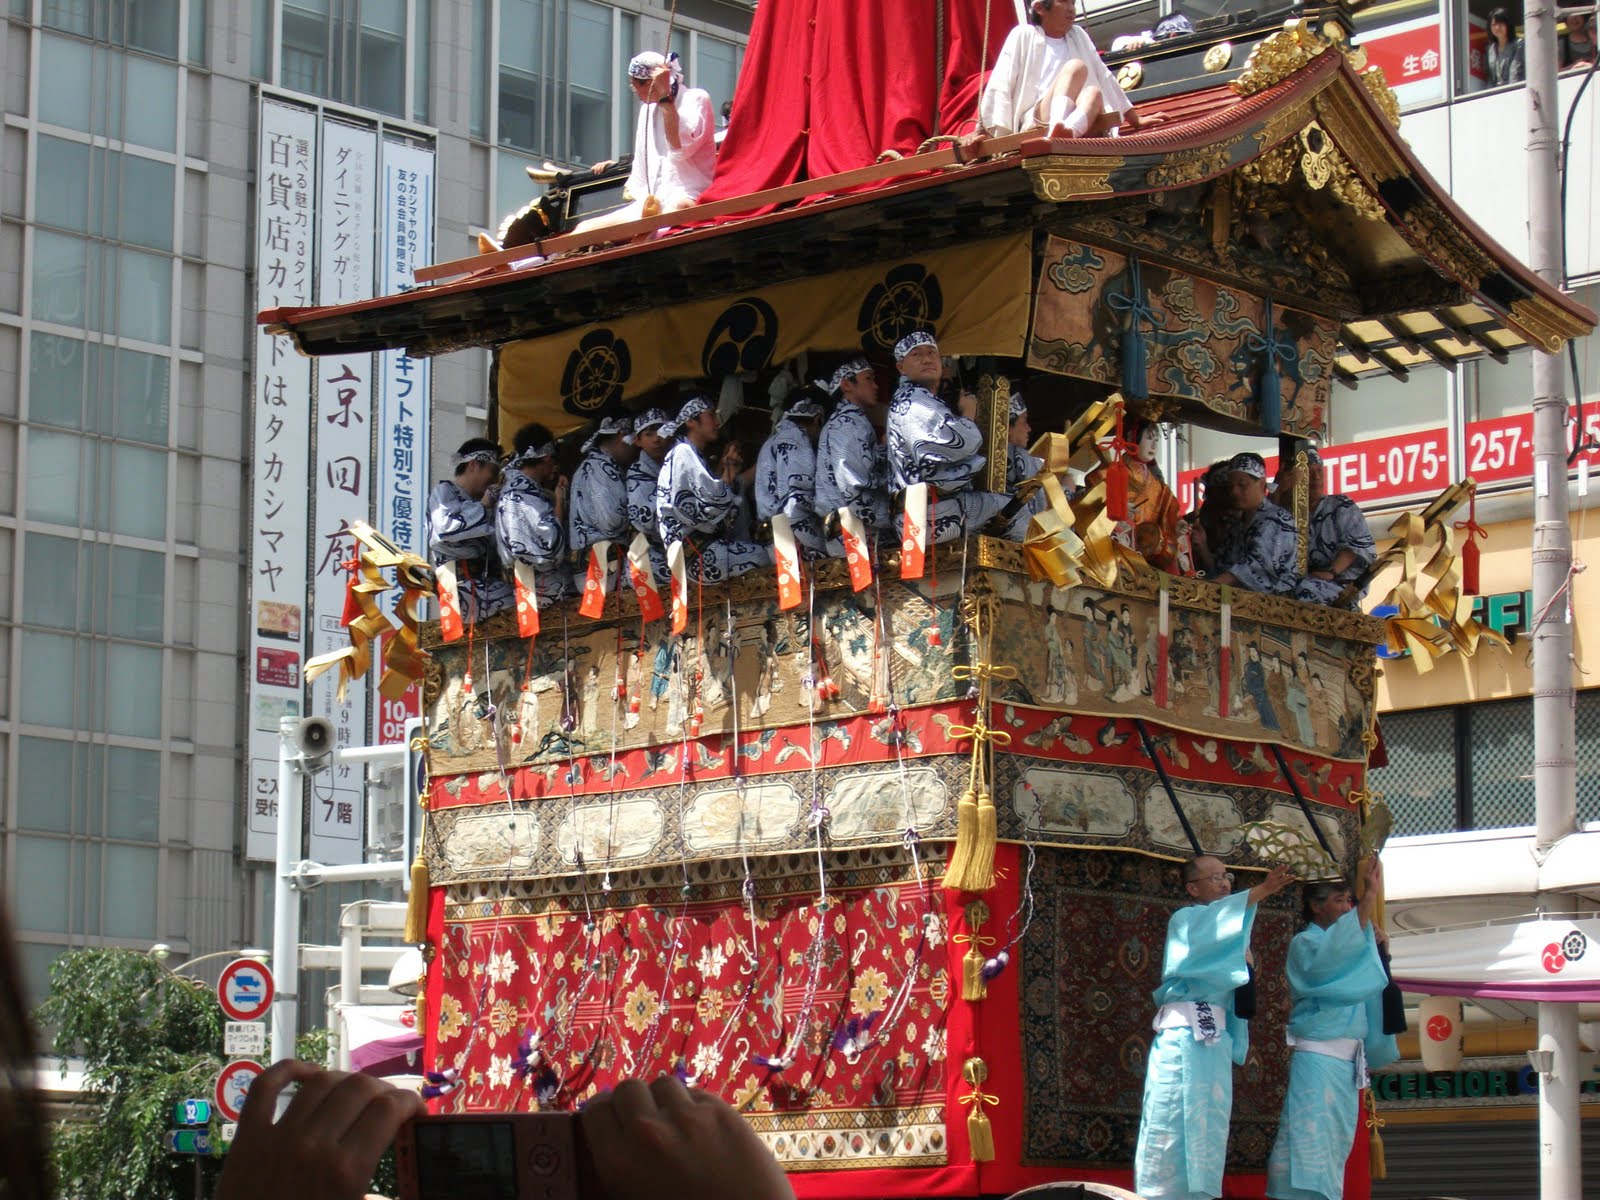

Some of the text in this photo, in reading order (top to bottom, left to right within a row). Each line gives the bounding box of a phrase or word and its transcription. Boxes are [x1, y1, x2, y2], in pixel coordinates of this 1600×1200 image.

[1402, 49, 1439, 77] 生命
[334, 146, 353, 301] ダイニングガー
[383, 725, 405, 739] OF
[322, 800, 353, 825] 7階
[1371, 1069, 1508, 1101] XCELSIOR
